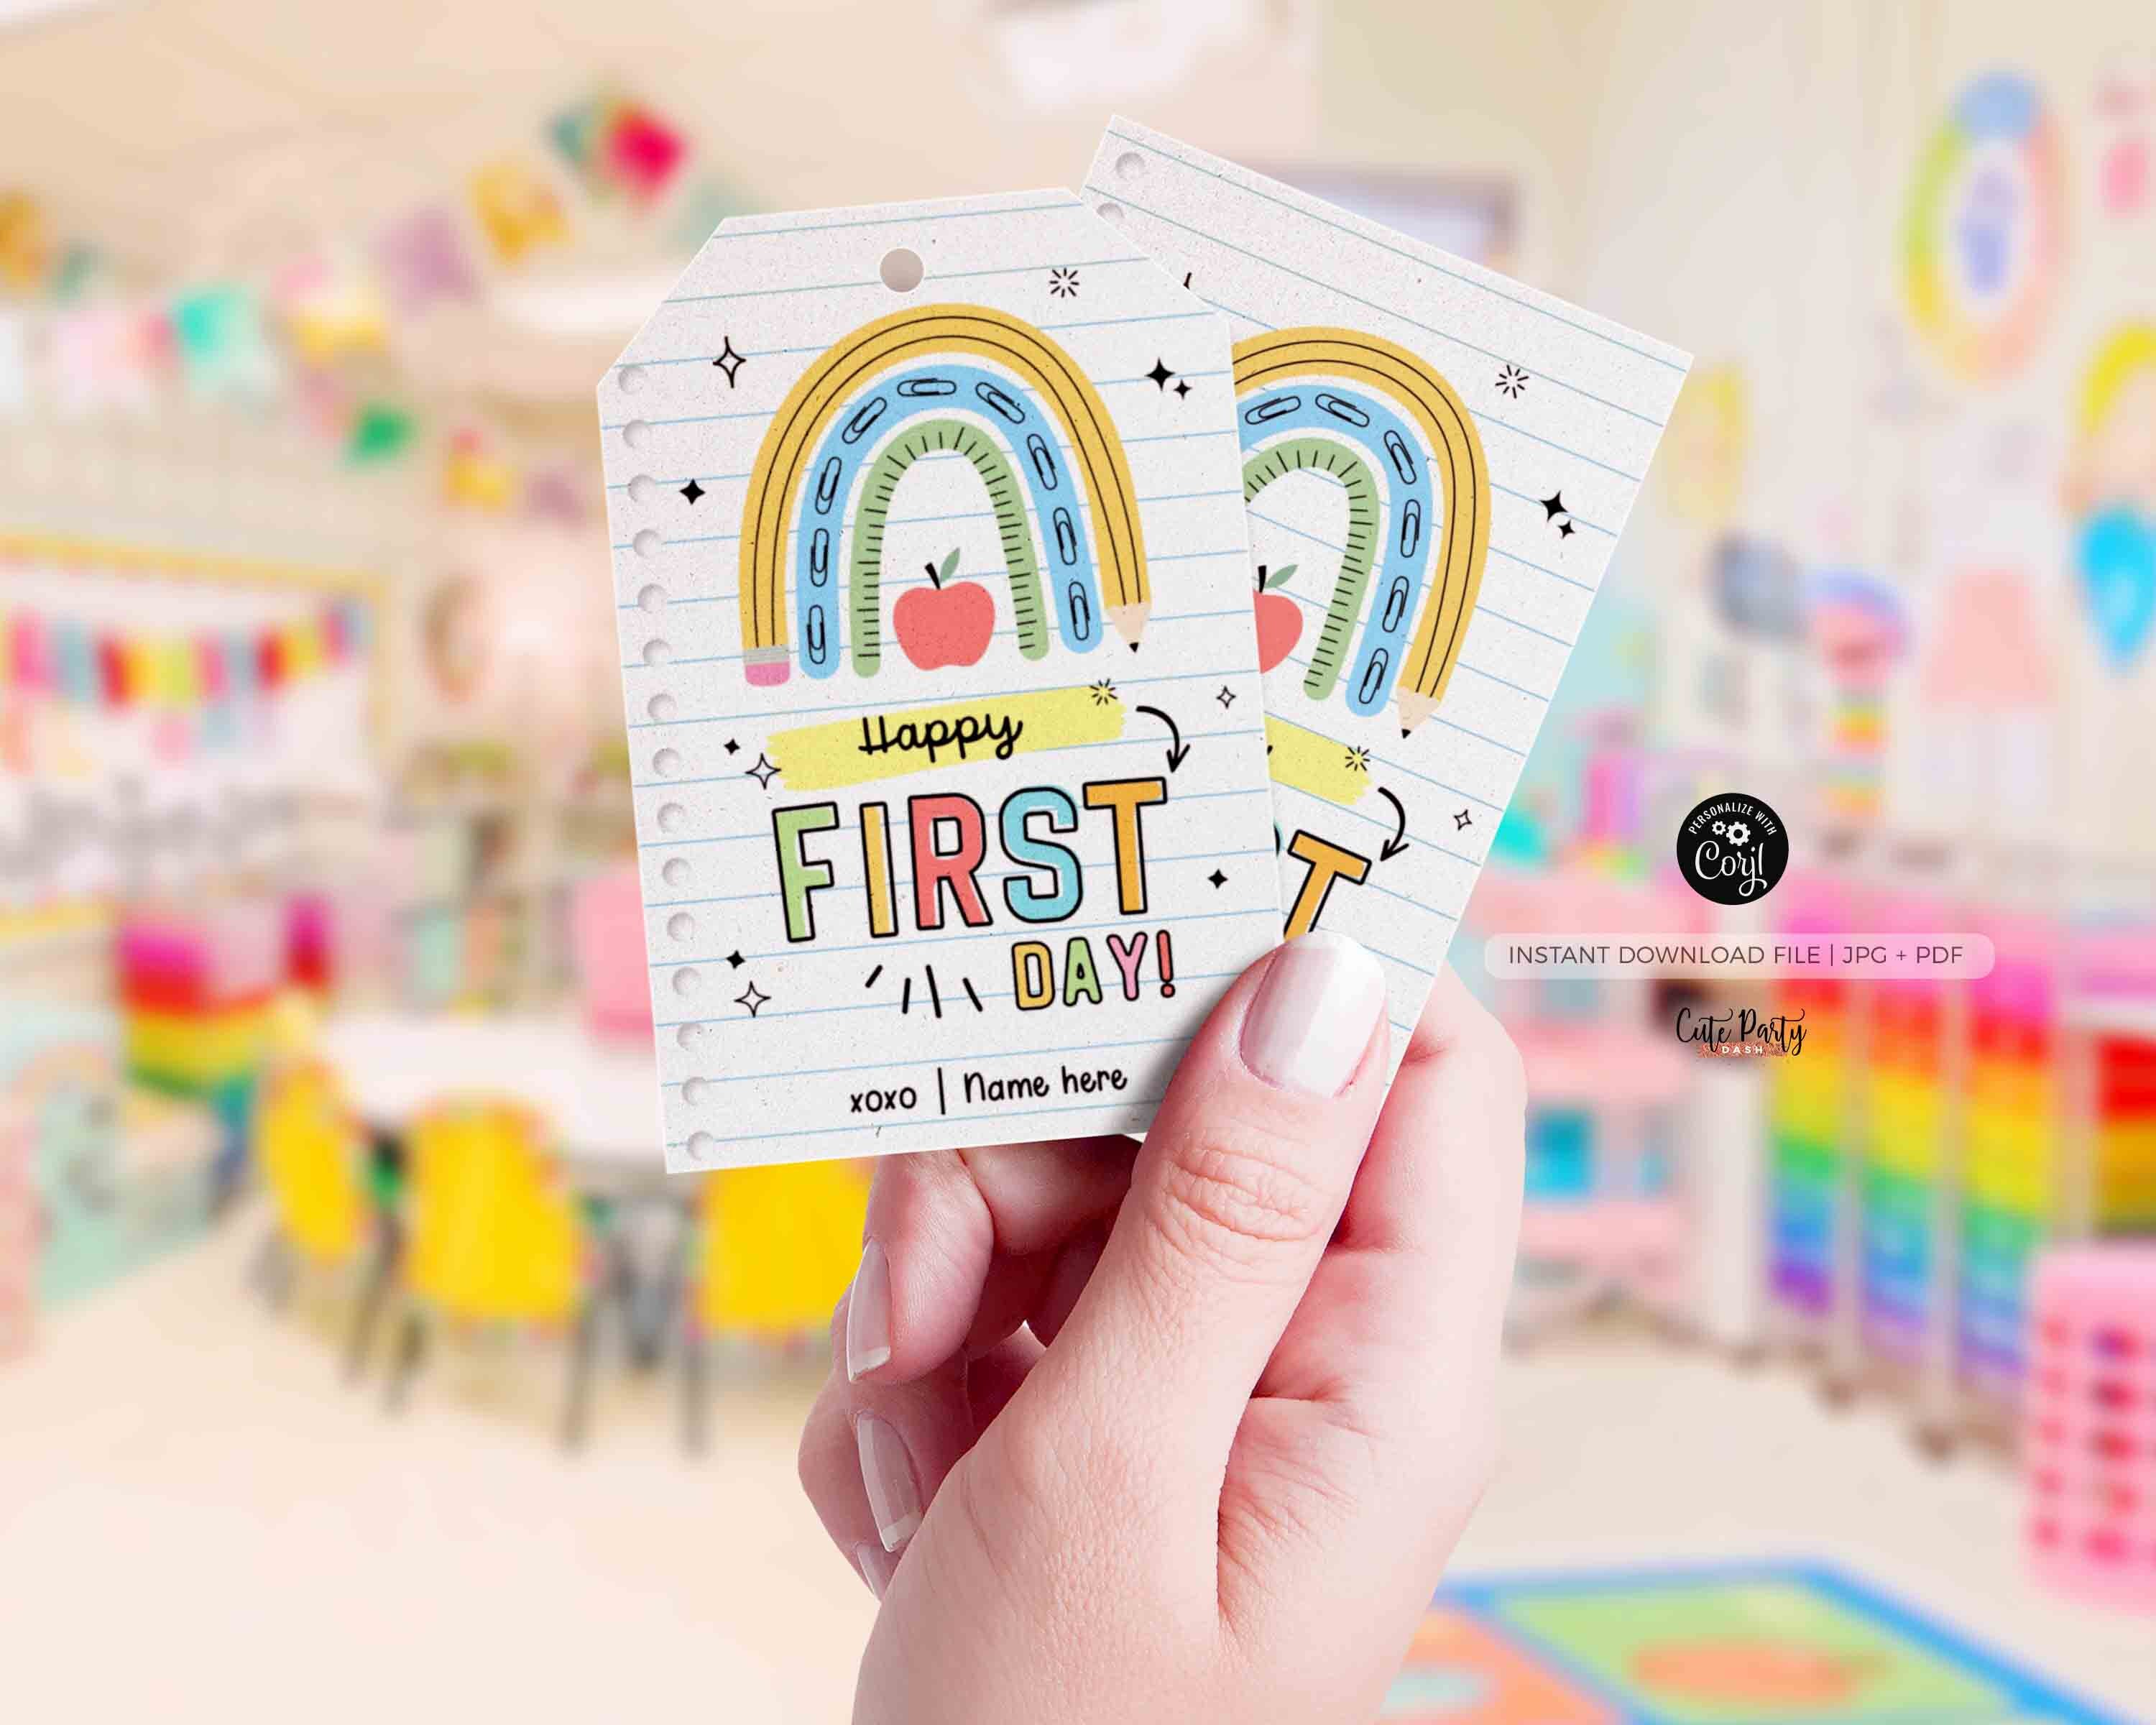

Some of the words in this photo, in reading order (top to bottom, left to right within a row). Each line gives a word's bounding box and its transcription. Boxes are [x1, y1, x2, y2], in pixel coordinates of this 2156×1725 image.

[858, 713, 1024, 763] Happy
[771, 776, 1169, 944] FIRST
[1011, 929, 1176, 1011] DAY!
[850, 1086, 917, 1113] xoxo
[964, 1071, 1050, 1104] Name
[1061, 1065, 1128, 1095] here
